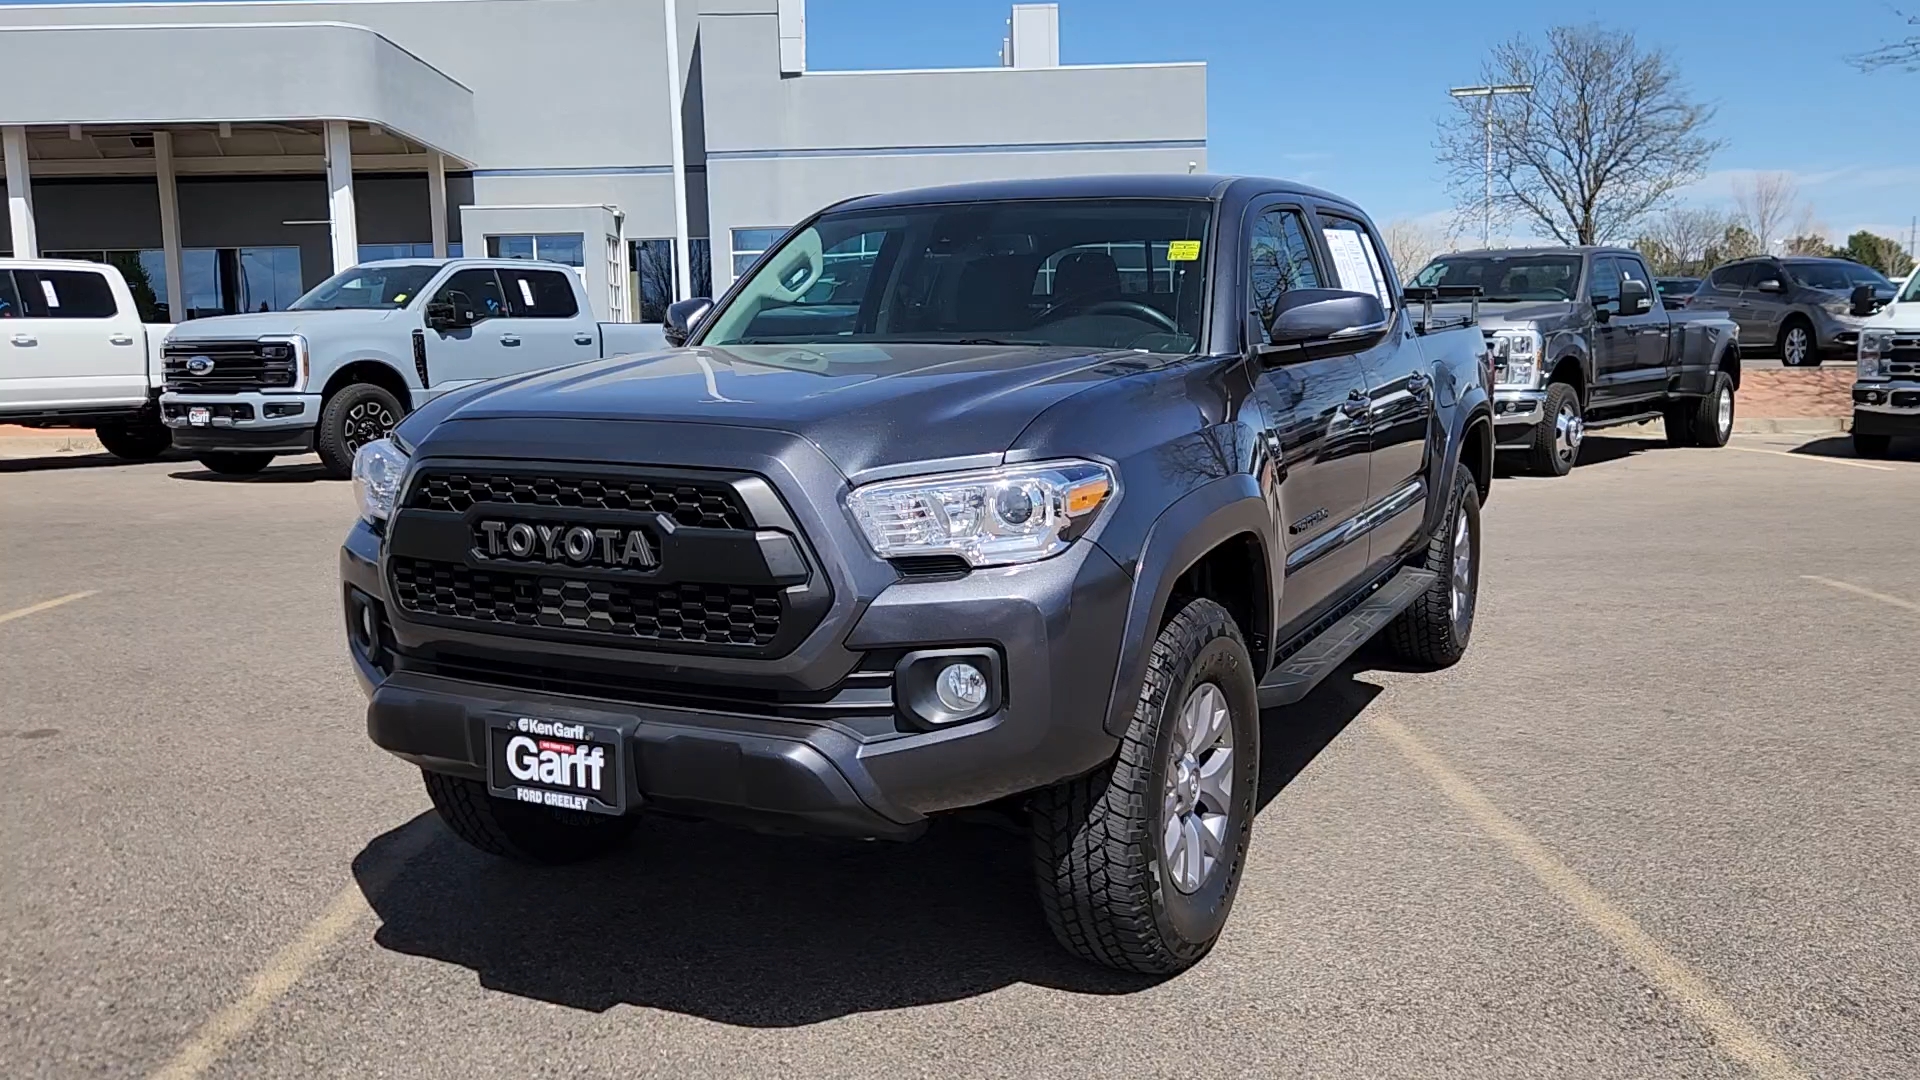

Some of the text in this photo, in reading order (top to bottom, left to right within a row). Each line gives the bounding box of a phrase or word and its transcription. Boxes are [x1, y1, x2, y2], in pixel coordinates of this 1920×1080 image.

[481, 520, 655, 566] TOYOTA
[506, 736, 604, 790] Garff
[517, 787, 588, 811] FORD GREELEY
